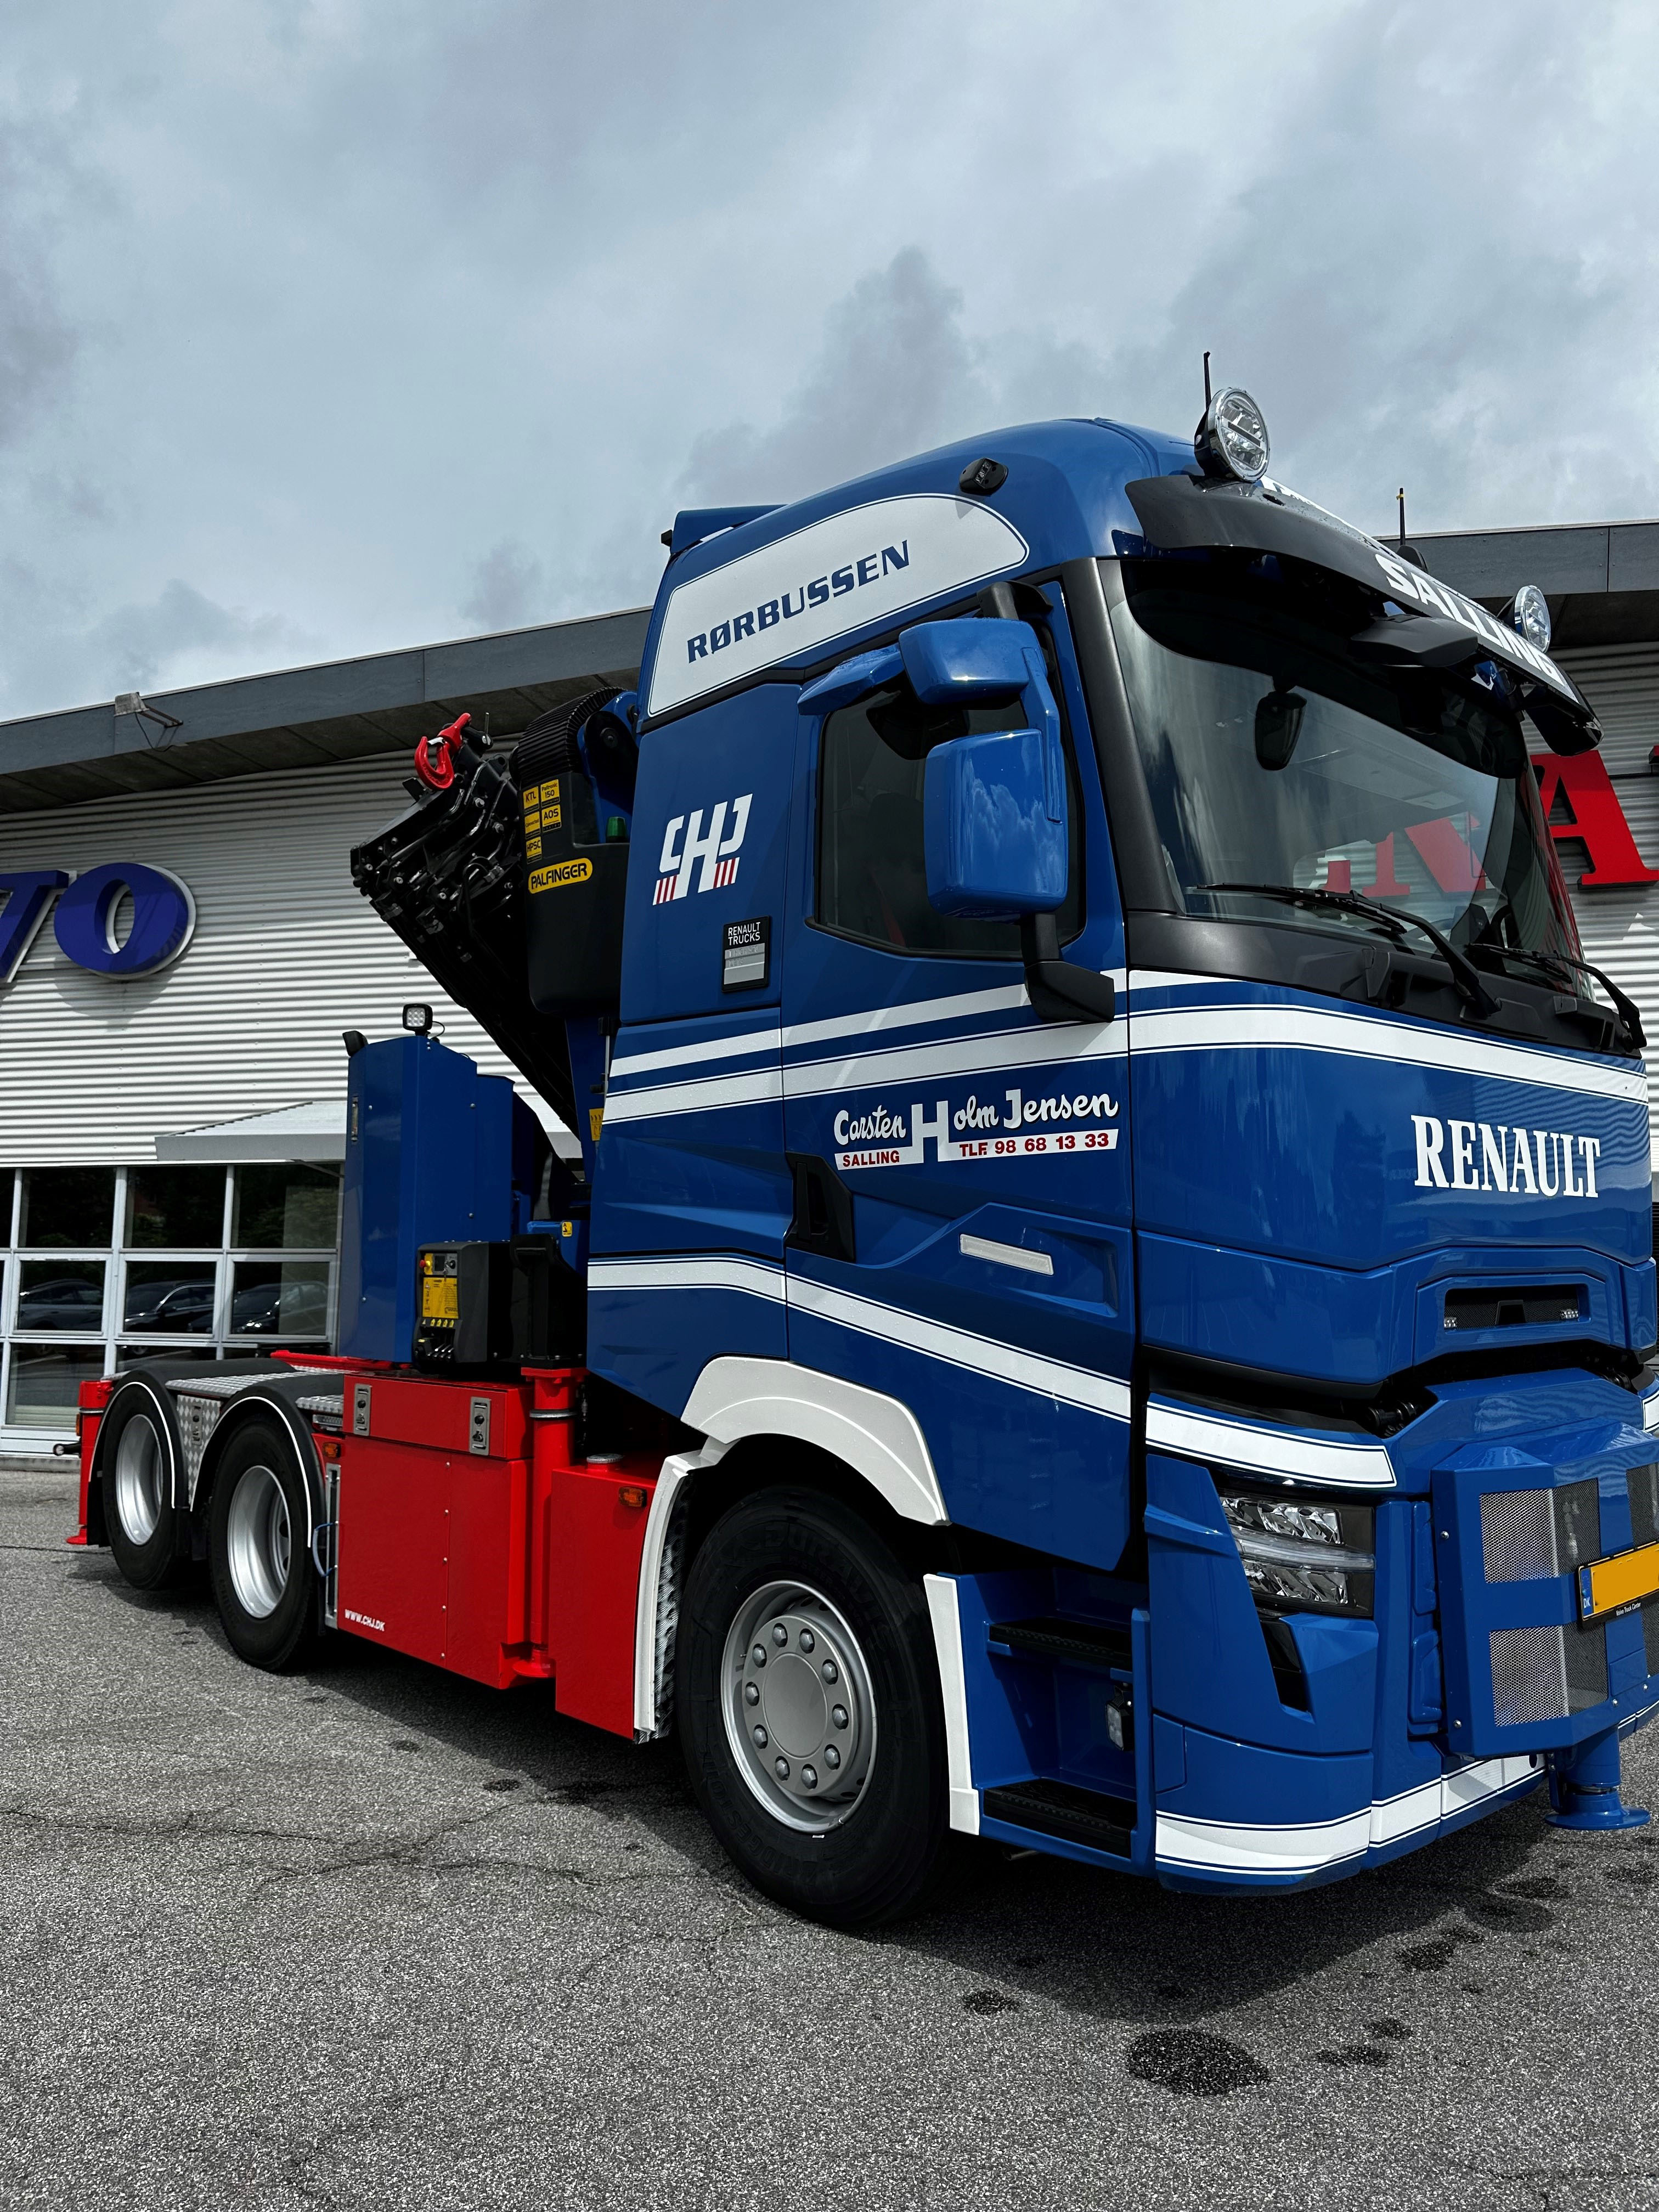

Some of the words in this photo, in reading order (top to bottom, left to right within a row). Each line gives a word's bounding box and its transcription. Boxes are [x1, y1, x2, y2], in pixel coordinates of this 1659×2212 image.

[687, 539, 910, 663] RØRBUSSEN
[1375, 554, 1565, 687] SALLING
[659, 793, 753, 897] CHJ
[531, 862, 588, 889] PALFINGER
[728, 922, 761, 937] RENAULT
[728, 932, 760, 946] TRUCKS
[834, 1104, 906, 1146] Carsten
[1003, 1088, 1120, 1130] Jensen
[995, 1140, 1017, 1155] 98
[1024, 1137, 1047, 1152] 68
[1056, 1135, 1076, 1150] 13
[1085, 1133, 1109, 1148] 33
[1410, 1115, 1600, 1198] RENAULT
[843, 1150, 900, 1167] SALLING
[1583, 1596, 1591, 1609] DK
[345, 1609, 386, 1632] WWW.CHJ.DK
